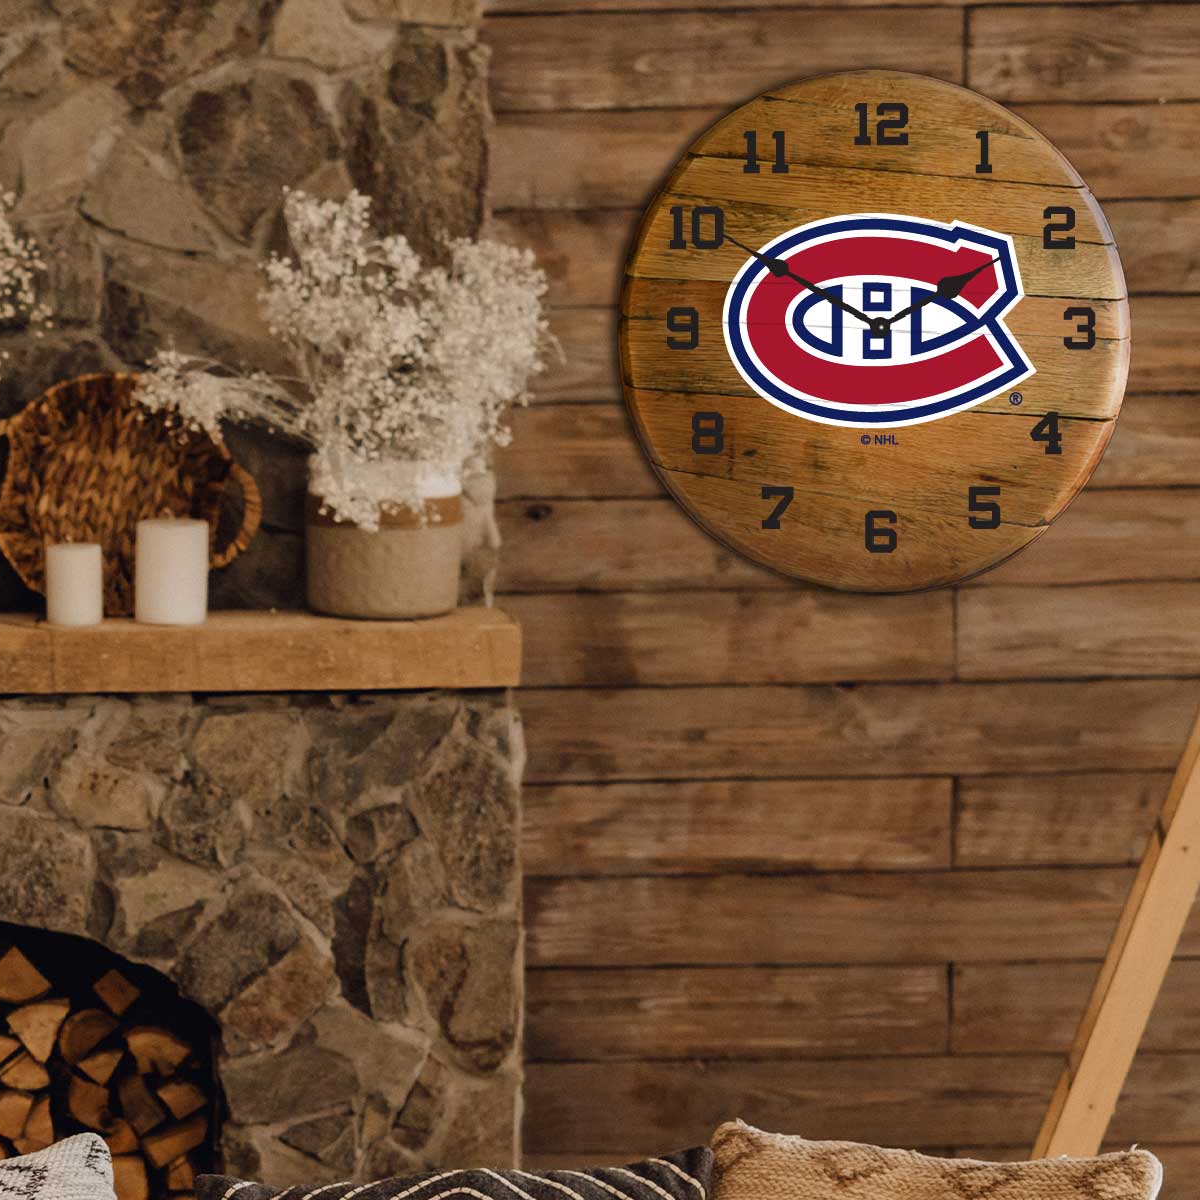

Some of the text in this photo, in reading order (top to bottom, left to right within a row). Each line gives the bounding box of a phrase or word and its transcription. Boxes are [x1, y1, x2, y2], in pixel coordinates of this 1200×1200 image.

[854, 102, 909, 146] 12
[743, 130, 789, 174] 11
[975, 130, 993, 174] 1
[669, 206, 724, 250] 10
[1043, 206, 1076, 250] 2
[666, 307, 700, 350] 9
[1063, 307, 1097, 350] 3
[691, 411, 725, 455] 8
[874, 434, 900, 446] NHL
[1029, 411, 1062, 455] 4
[761, 486, 794, 530] 7
[968, 486, 1002, 530] 5
[864, 510, 898, 553] 6
